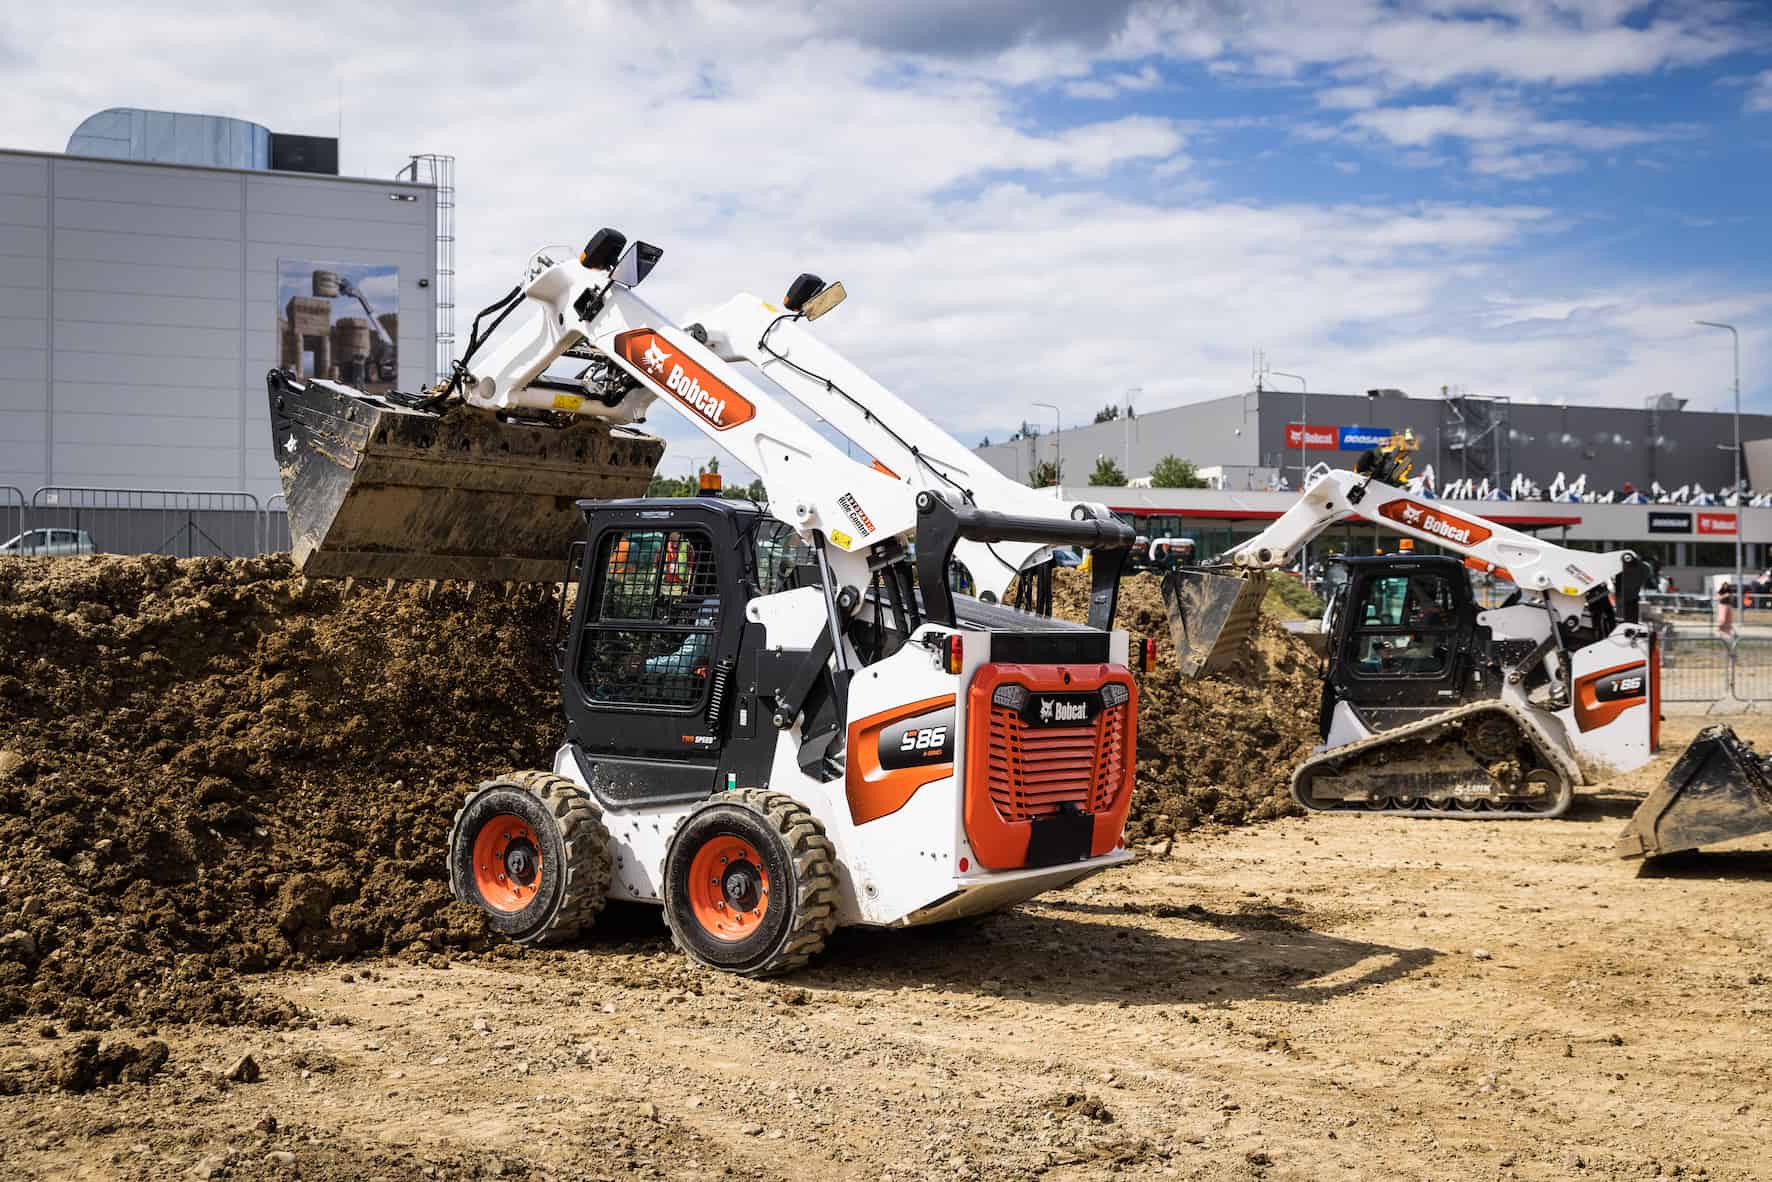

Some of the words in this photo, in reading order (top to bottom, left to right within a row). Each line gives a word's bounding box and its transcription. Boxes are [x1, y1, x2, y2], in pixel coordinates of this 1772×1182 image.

[666, 364, 726, 423] Bobcat
[849, 512, 870, 537] Control
[1423, 515, 1470, 543] Bobcat
[1055, 701, 1086, 720] Bobcat
[900, 727, 947, 751] S86
